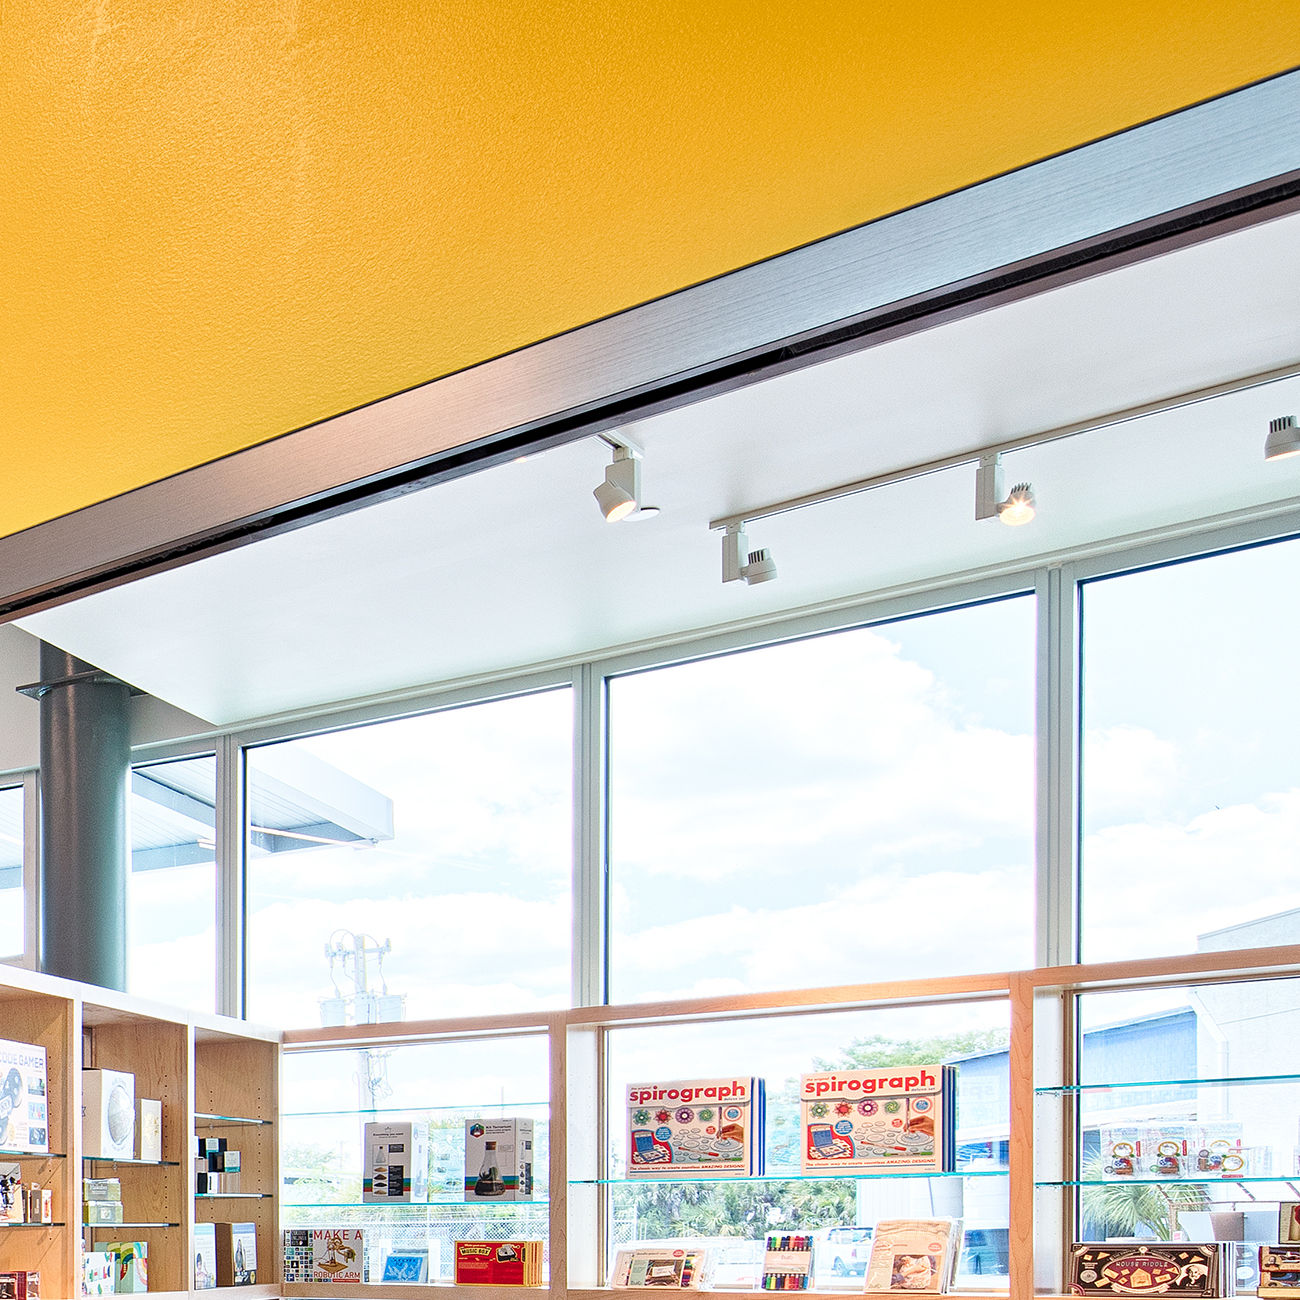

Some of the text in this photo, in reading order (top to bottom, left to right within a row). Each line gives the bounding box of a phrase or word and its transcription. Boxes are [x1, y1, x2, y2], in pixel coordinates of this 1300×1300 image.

[19, 1054, 44, 1069] GAMER
[805, 1070, 935, 1096] spirograph
[629, 1081, 745, 1104] spirograph
[314, 1230, 363, 1241] MAKE A
[461, 1247, 490, 1255] MUSIC BOX
